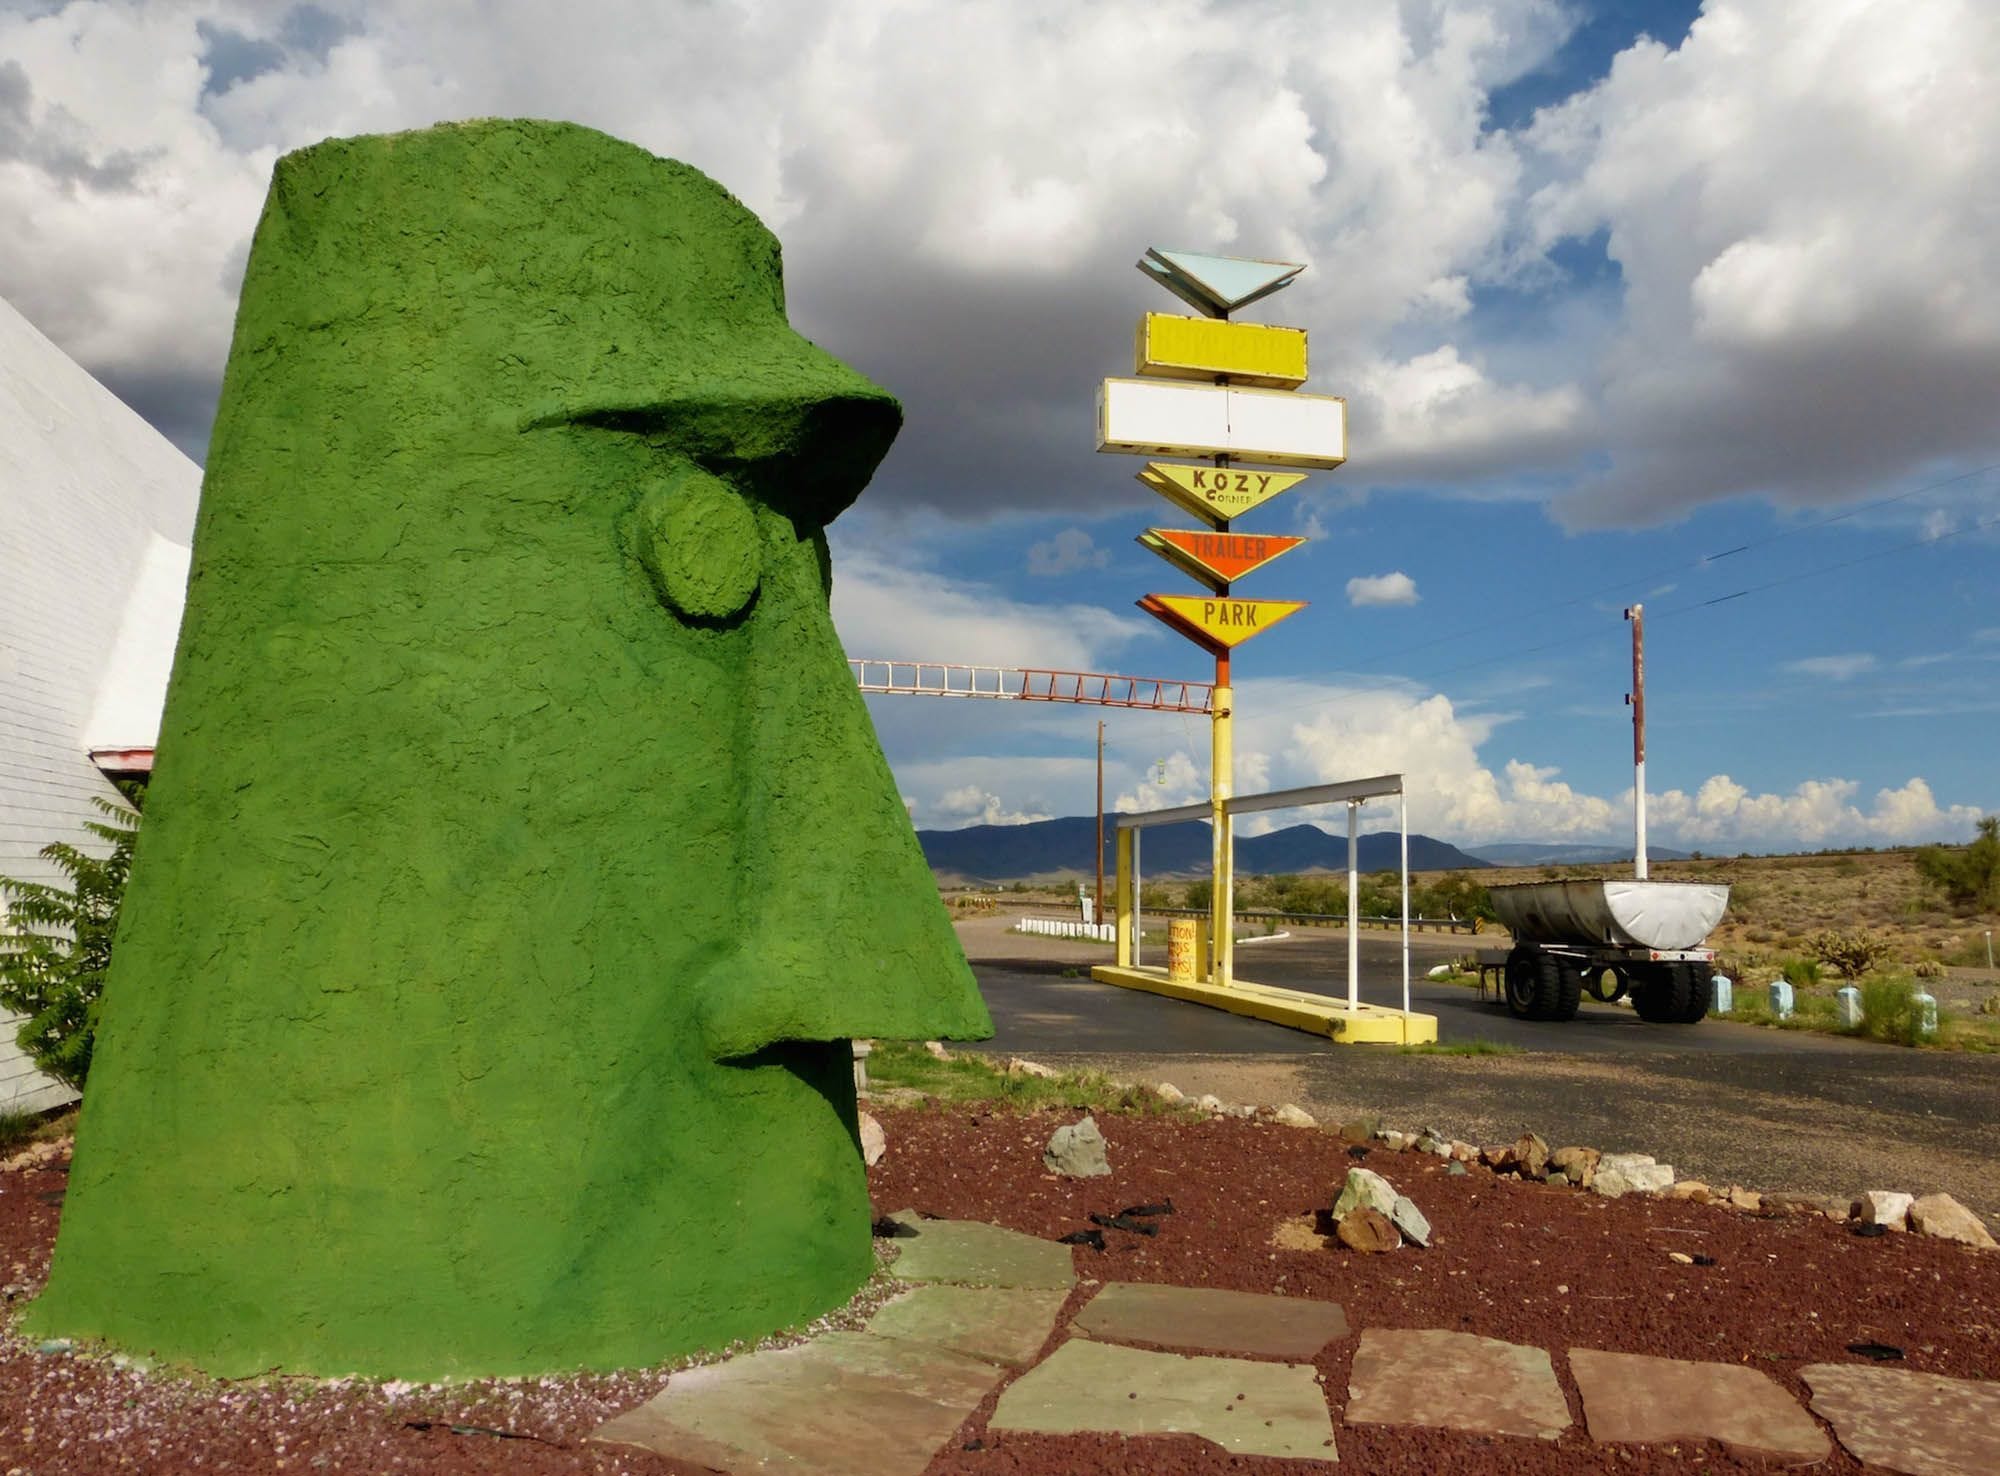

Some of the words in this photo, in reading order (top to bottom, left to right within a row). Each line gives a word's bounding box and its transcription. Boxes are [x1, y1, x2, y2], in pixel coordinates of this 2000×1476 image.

[1194, 470, 1271, 494] KOZY
[1192, 533, 1266, 560] TRAILER
[1204, 602, 1257, 626] PARK
